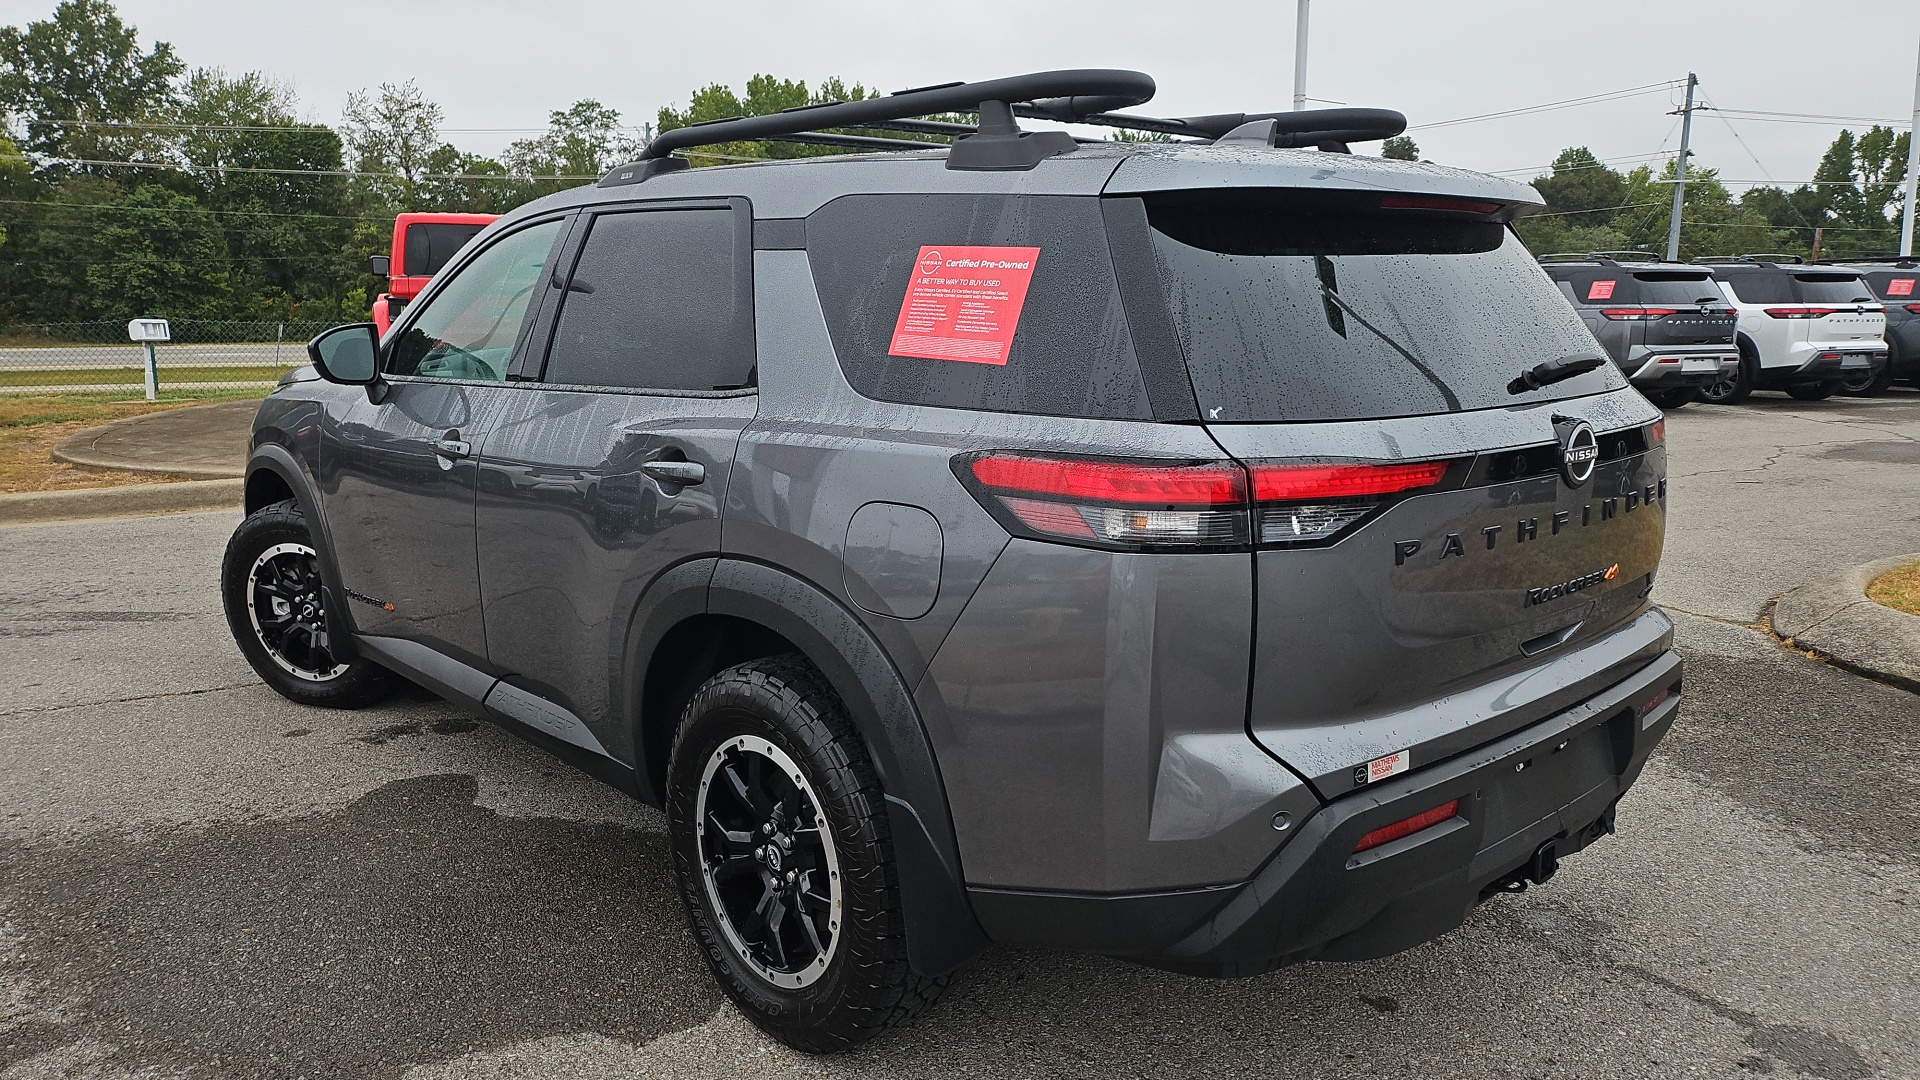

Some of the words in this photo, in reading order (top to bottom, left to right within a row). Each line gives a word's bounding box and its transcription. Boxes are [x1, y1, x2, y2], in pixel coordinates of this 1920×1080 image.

[946, 259, 980, 268] Certified
[981, 260, 1029, 269] Pre-Owned
[1394, 478, 1666, 565] PATHFINDER
[1371, 754, 1400, 769] MATHEWS
[1371, 764, 1393, 777] NISSAN
